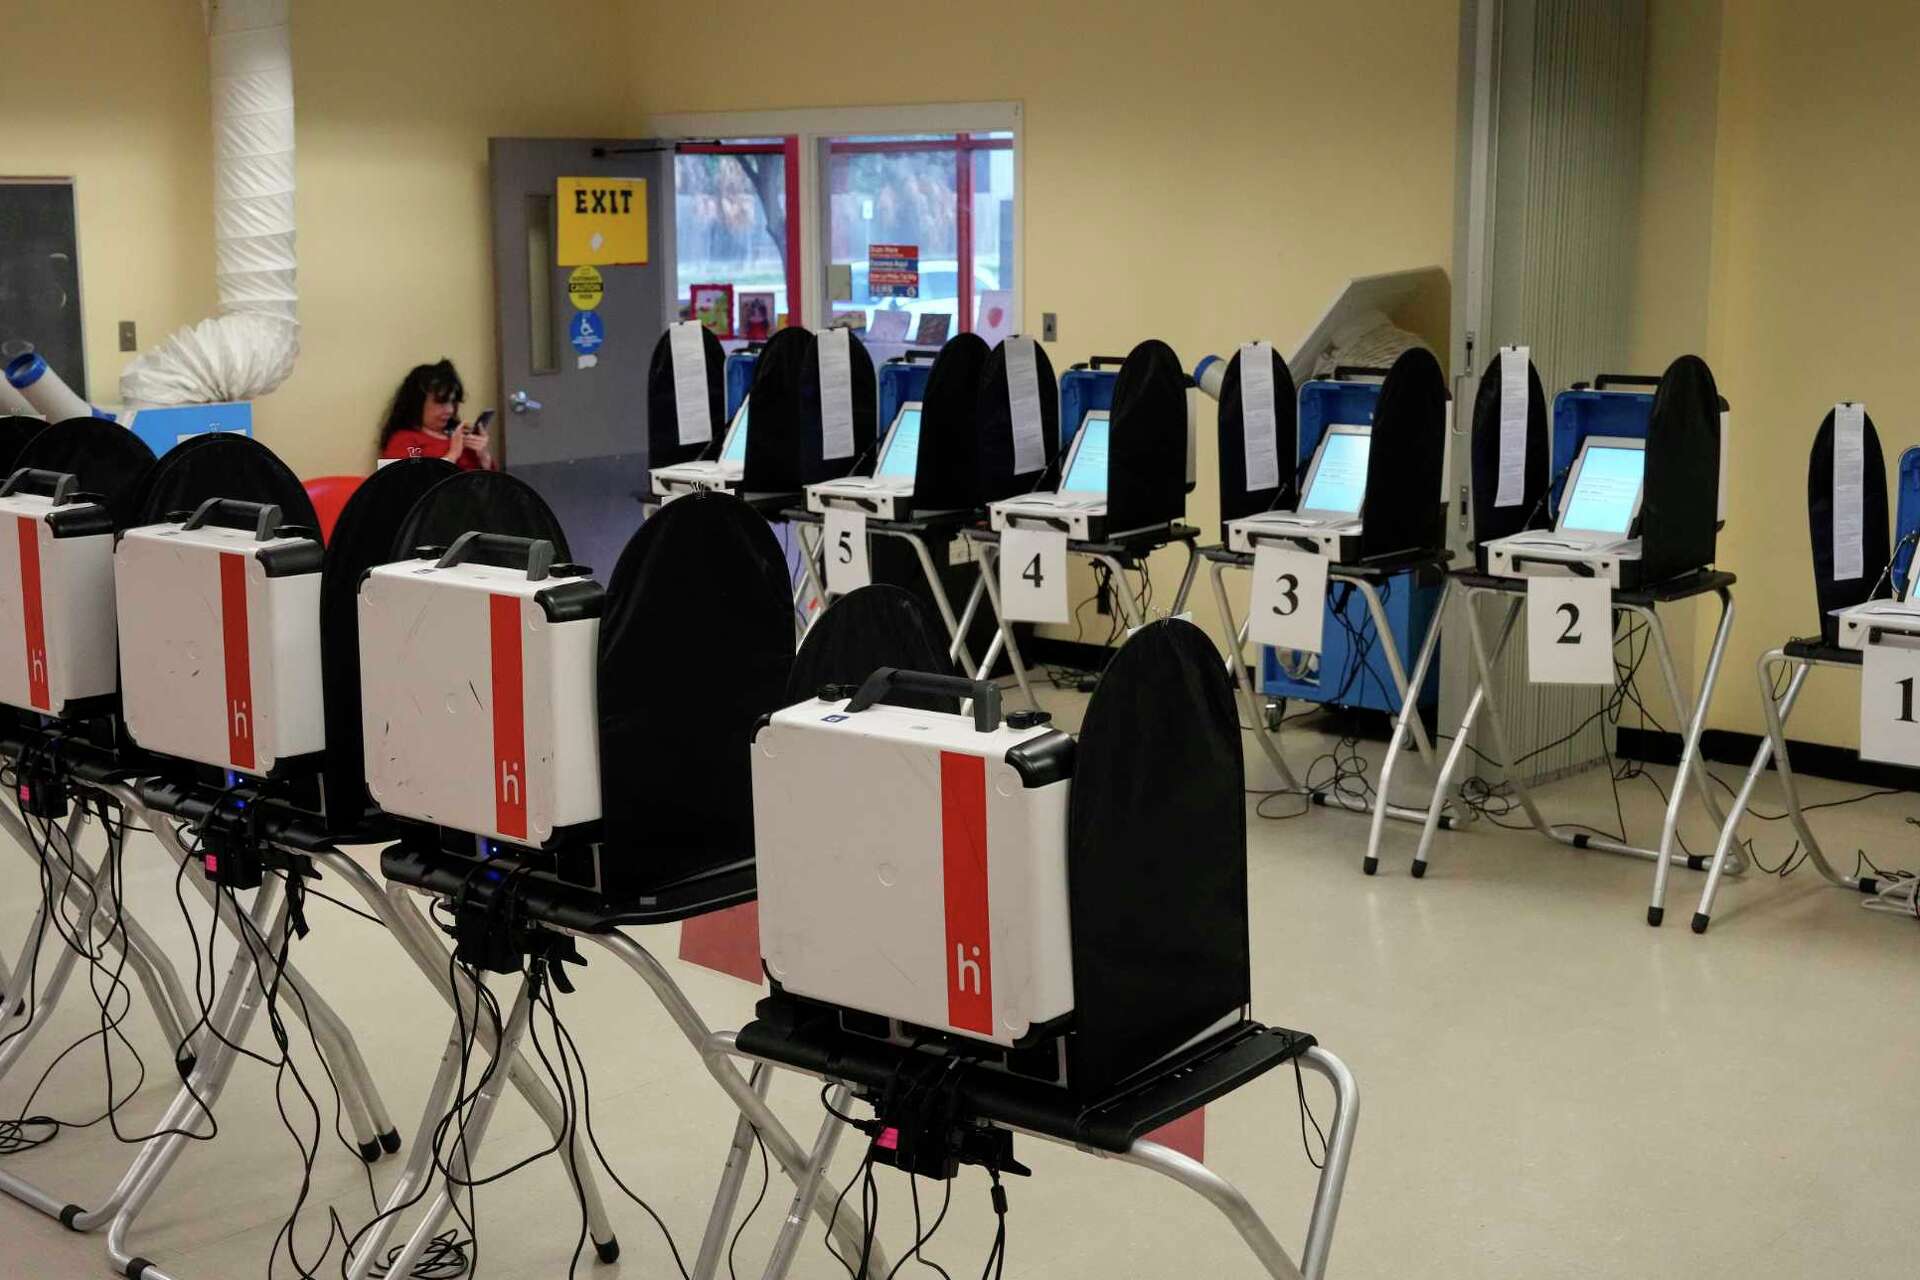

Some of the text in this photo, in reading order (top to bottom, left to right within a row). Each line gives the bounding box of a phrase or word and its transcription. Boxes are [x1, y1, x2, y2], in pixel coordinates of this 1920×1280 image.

[574, 190, 633, 214] EXIT
[838, 531, 853, 564] 5
[1022, 552, 1044, 588] 4
[1272, 573, 1299, 616] 3
[1556, 602, 1582, 644] 2
[234, 700, 248, 739] hi
[1895, 677, 1918, 723] 1
[502, 759, 520, 805] hi
[956, 943, 981, 995] hi
